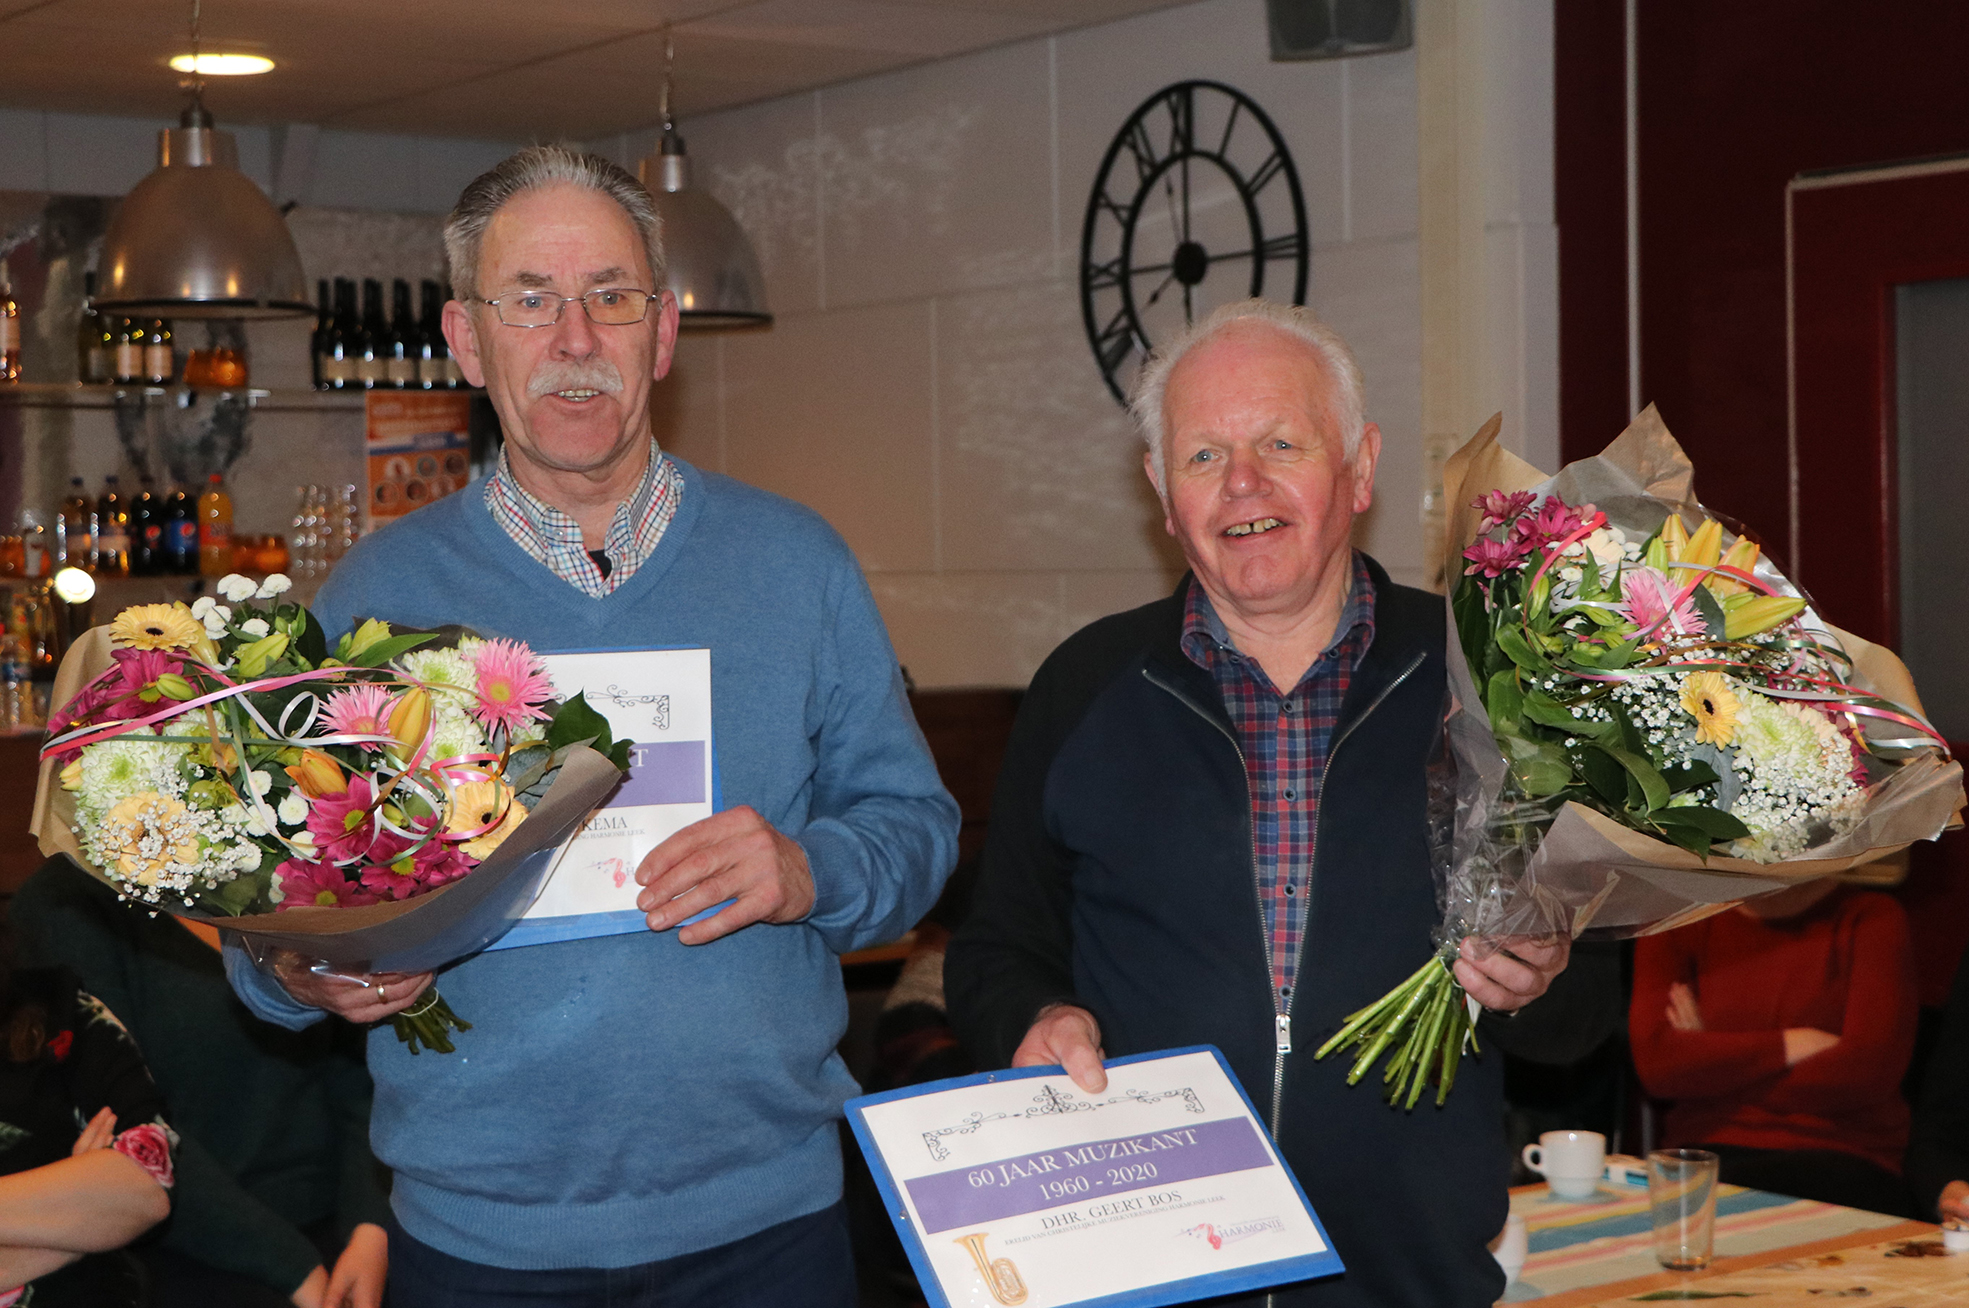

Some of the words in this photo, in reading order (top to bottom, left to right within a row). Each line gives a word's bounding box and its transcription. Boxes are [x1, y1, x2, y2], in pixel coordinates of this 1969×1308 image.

[968, 1168, 995, 1188] 60
[997, 1154, 1062, 1187] JAAR
[1062, 1129, 1198, 1168] MUZIKANT
[1039, 1175, 1090, 1200] 1960
[1106, 1161, 1158, 1186] 2020
[1041, 1210, 1086, 1229] DHR.
[1088, 1196, 1144, 1218] GEERT
[1147, 1190, 1183, 1206] BOS
[1218, 1218, 1284, 1238] HARMONIE
